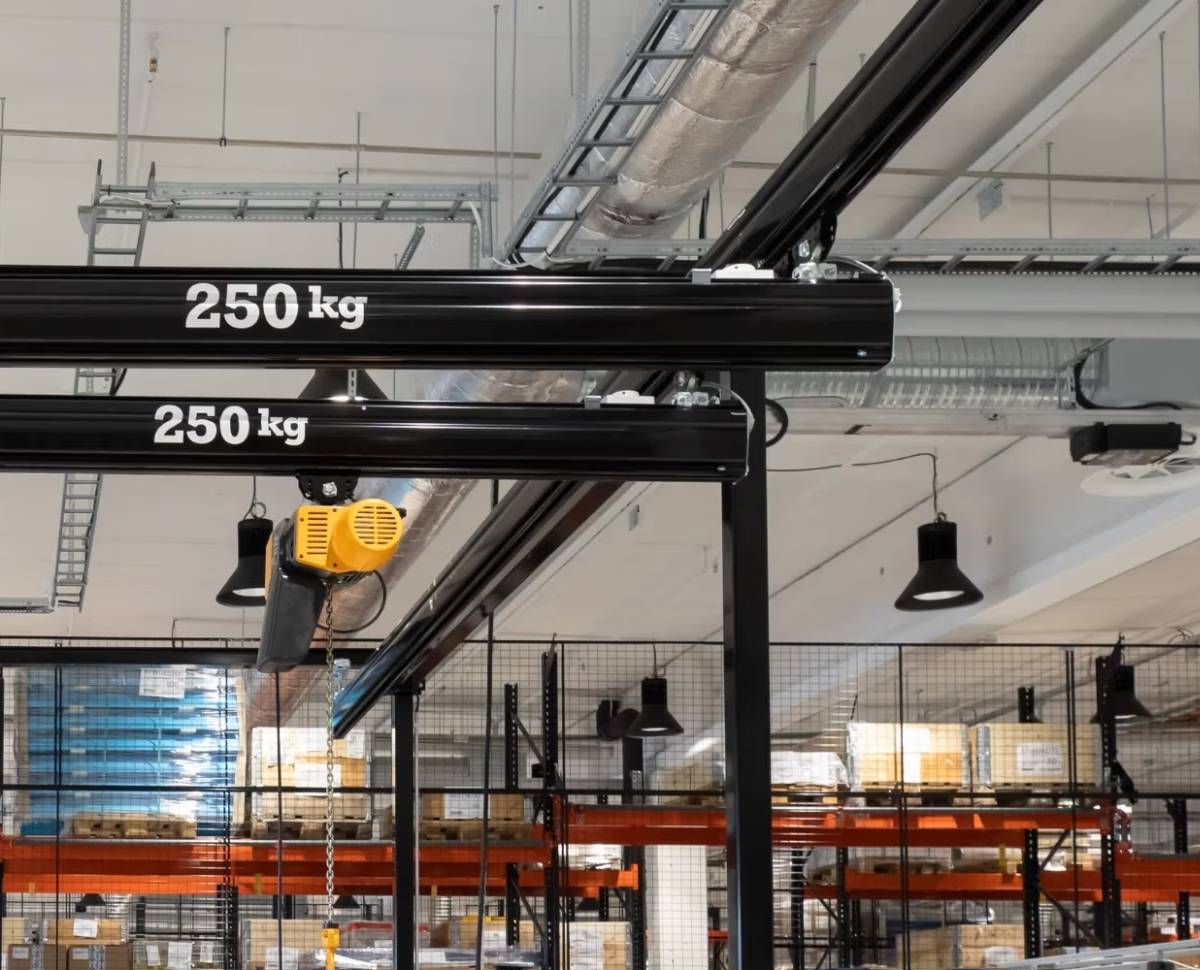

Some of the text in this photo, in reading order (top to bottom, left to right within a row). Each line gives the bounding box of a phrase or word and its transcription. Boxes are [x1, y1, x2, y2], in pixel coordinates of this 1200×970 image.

[185, 283, 298, 329] 250
[308, 285, 368, 330] kg
[153, 405, 250, 445] 250
[257, 408, 308, 446] kg
